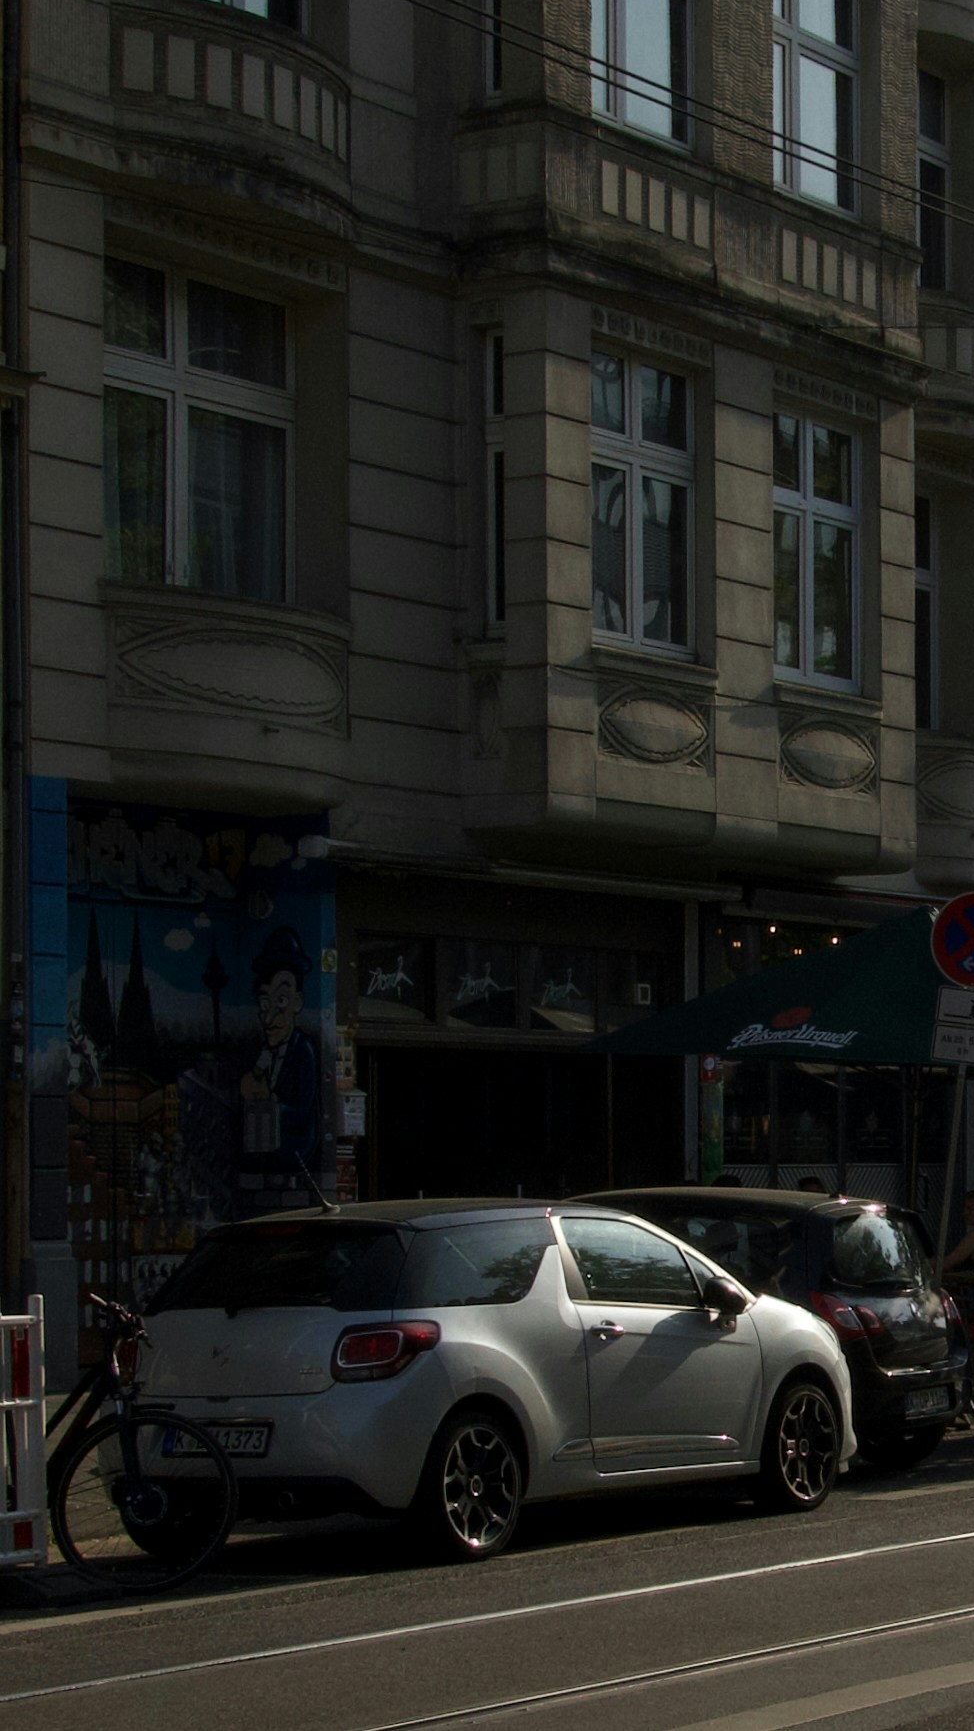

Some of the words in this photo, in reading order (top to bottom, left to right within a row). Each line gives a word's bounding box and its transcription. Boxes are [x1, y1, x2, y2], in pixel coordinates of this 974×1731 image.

[726, 1023, 800, 1051] Pilsner
[796, 1023, 859, 1047] Urquell
[224, 1429, 264, 1450] 1373
